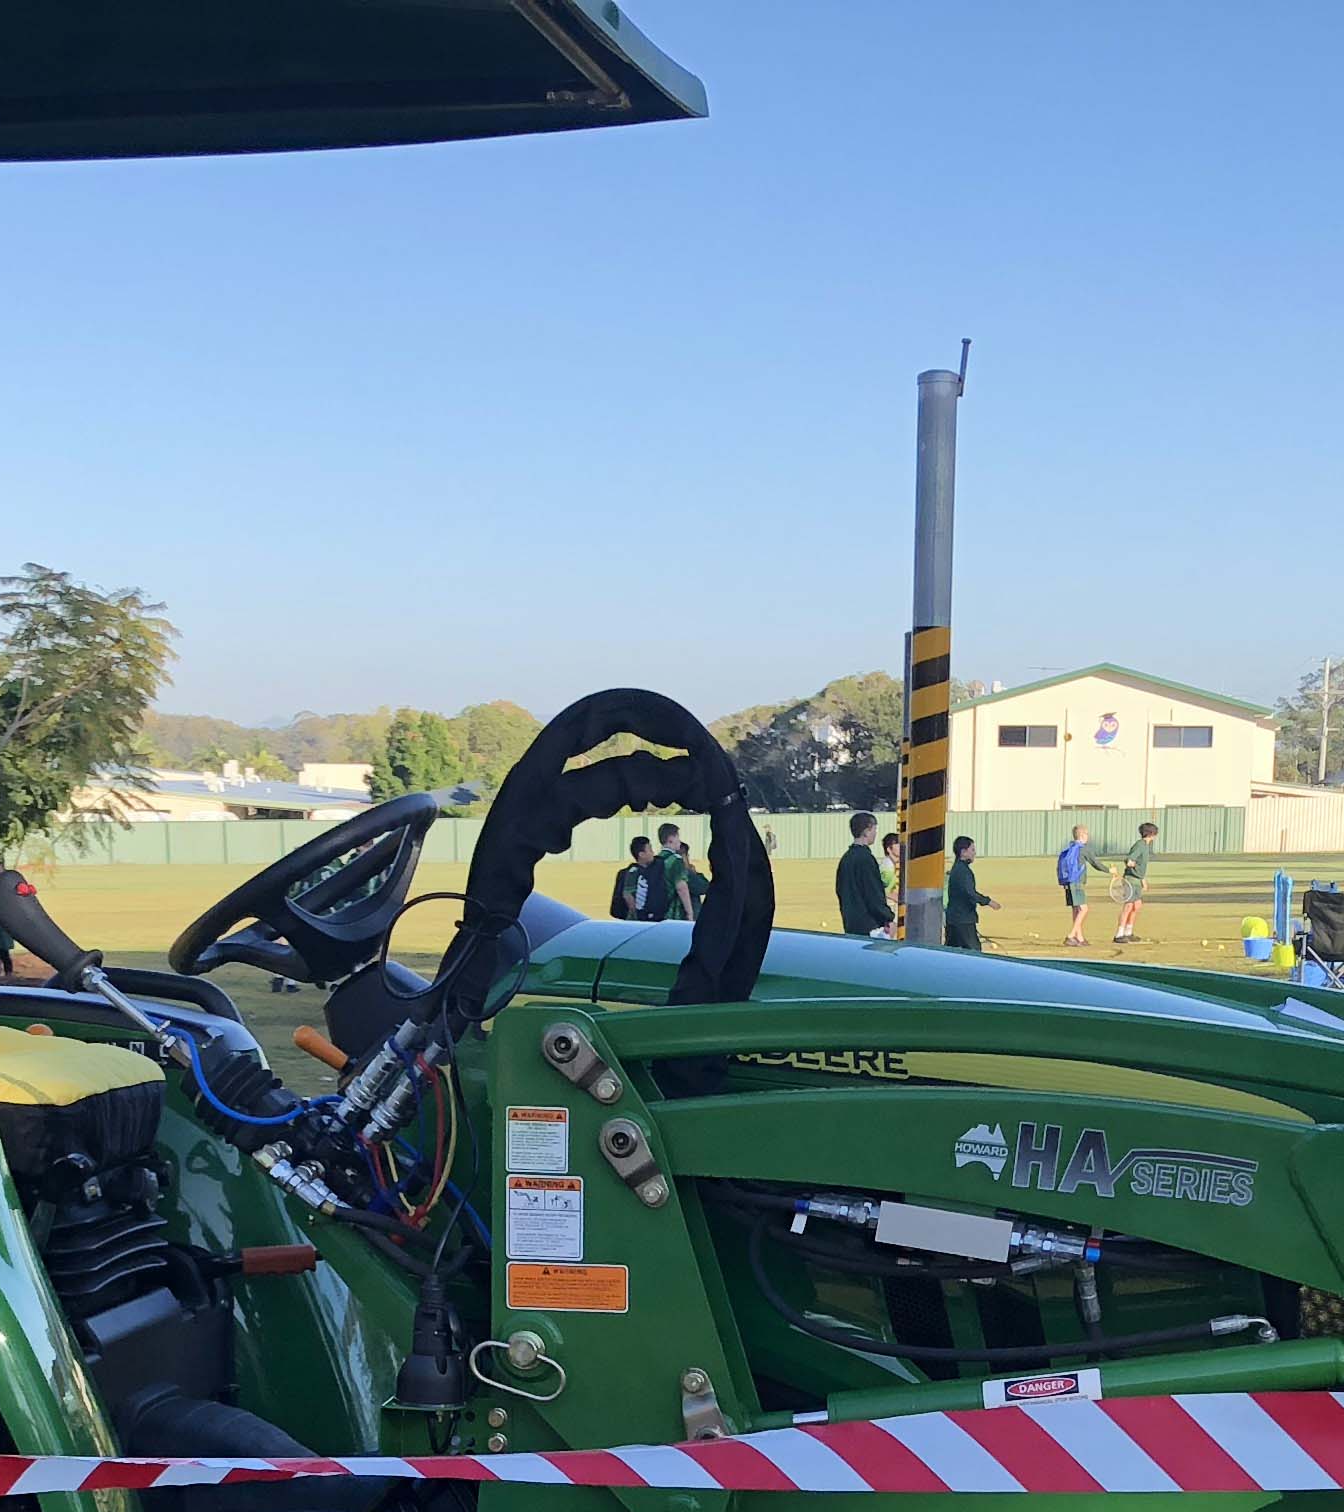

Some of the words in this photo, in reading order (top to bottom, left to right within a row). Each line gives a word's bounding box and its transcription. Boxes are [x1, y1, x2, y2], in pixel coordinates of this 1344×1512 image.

[954, 1141, 1009, 1158] HOWARD
[1011, 1121, 1115, 1198] HA
[1130, 1160, 1255, 1207] SERIES
[1018, 1380, 1065, 1394] DANGER
